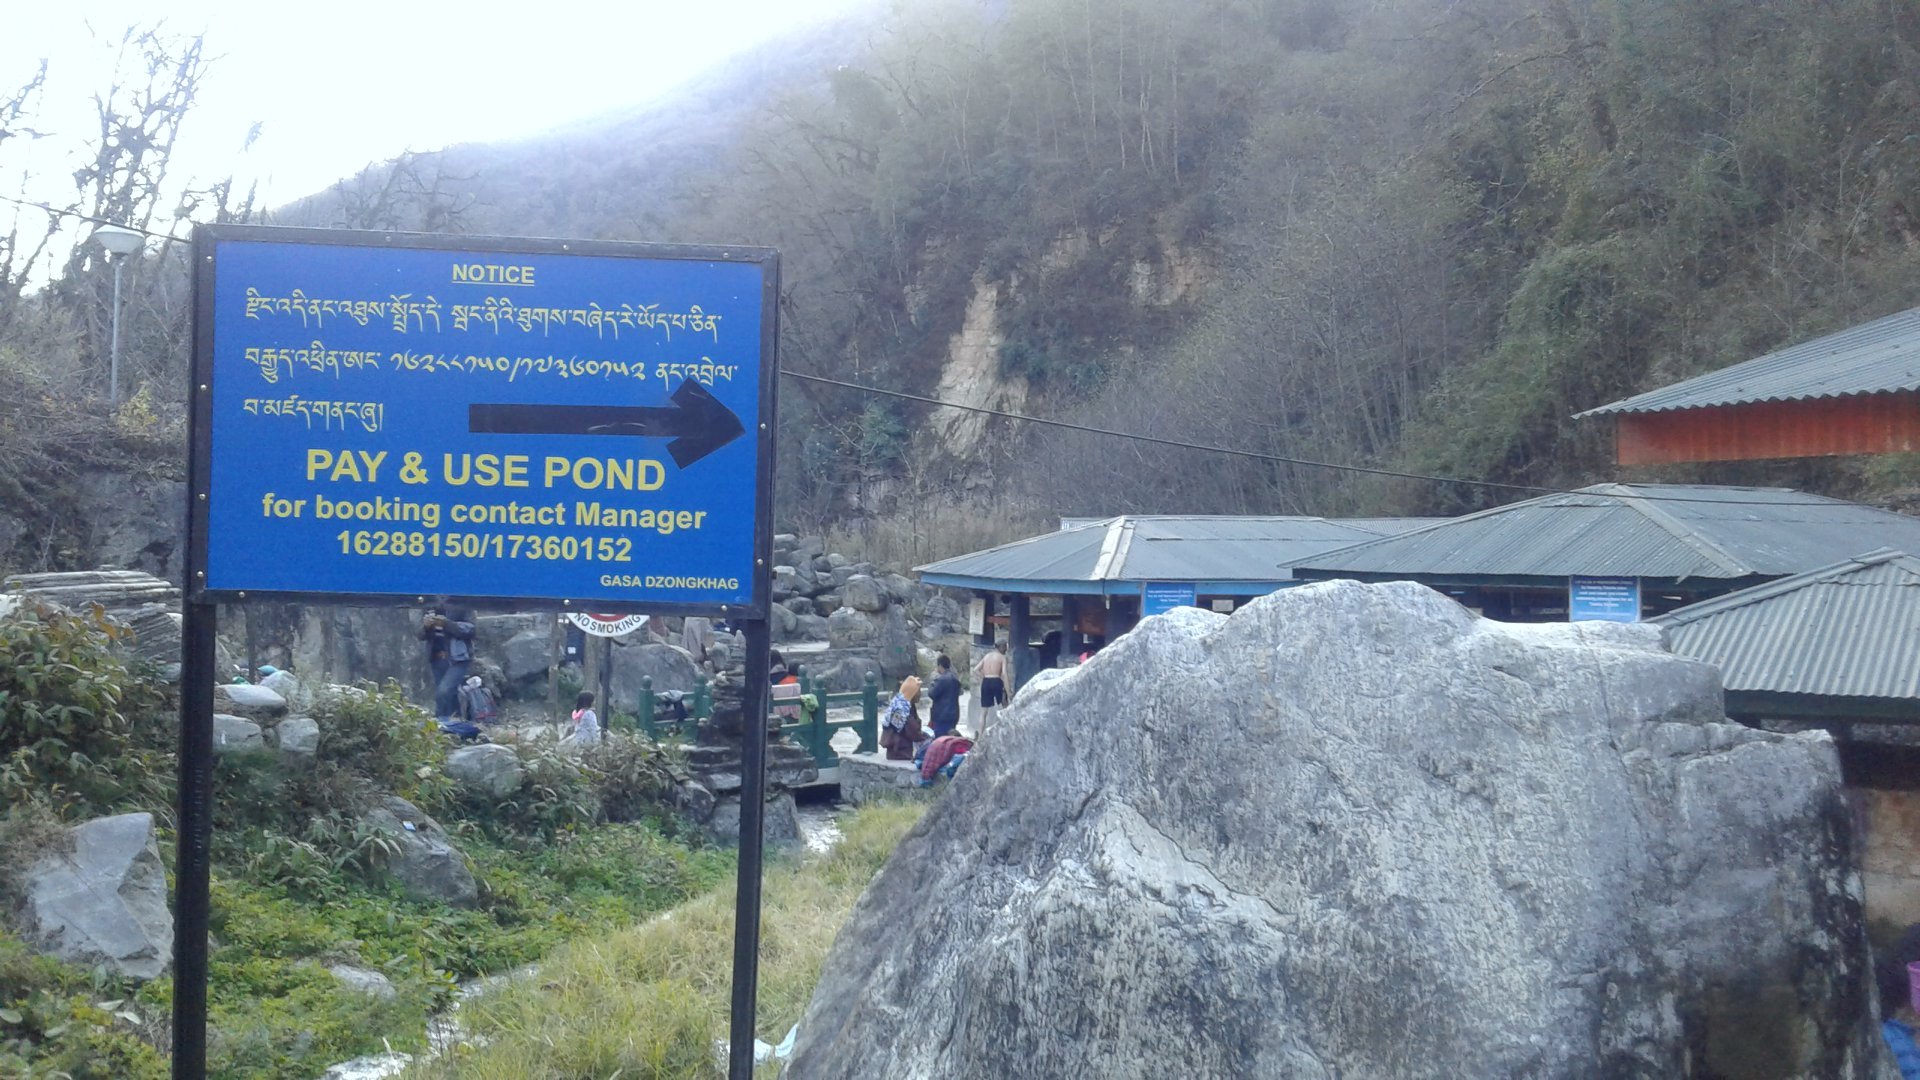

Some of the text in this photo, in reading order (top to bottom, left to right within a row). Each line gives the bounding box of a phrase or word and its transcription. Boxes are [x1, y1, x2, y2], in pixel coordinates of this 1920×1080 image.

[452, 263, 535, 285] NOTICE
[306, 449, 666, 491] PAY & USE POND
[262, 493, 707, 535] for booking contact Manager
[337, 530, 633, 562] 16288150/17360152
[600, 574, 739, 590] GASA DZONGKHAG
[589, 614, 641, 634] SMOKING
